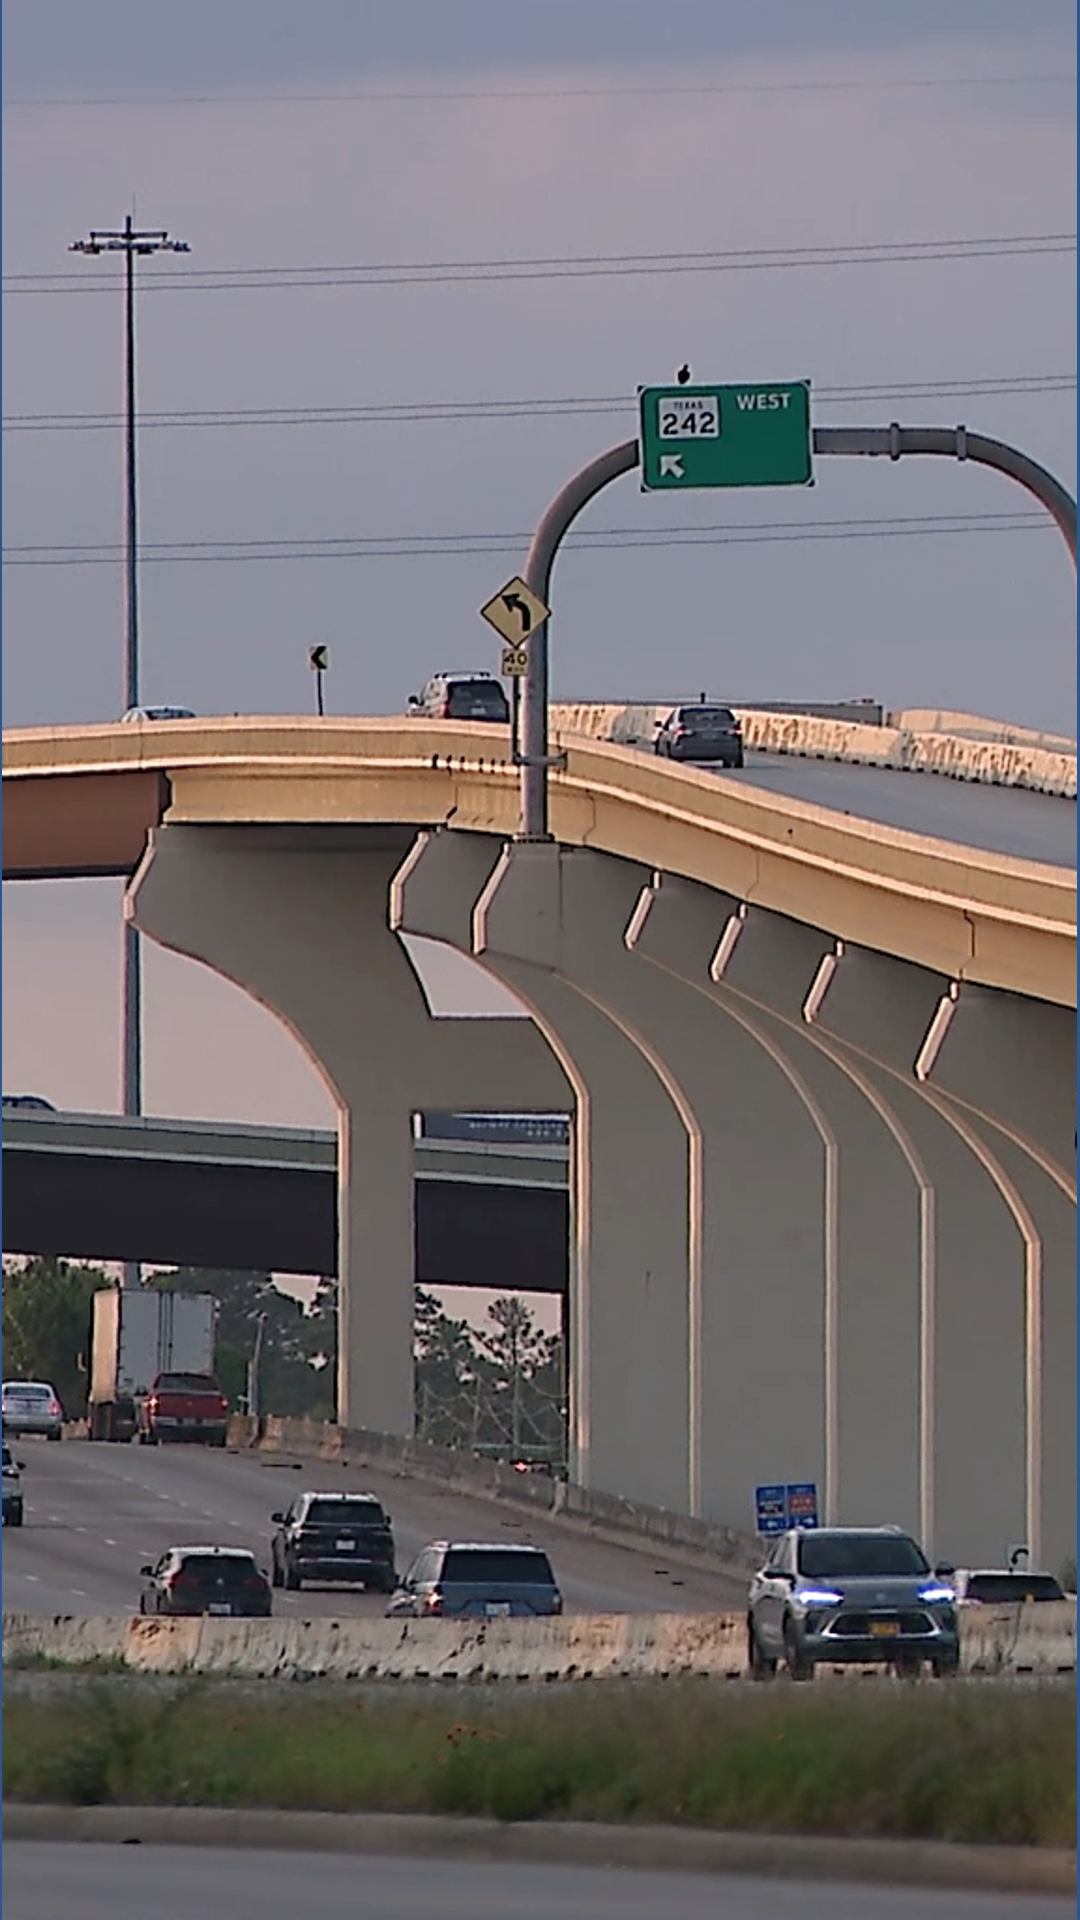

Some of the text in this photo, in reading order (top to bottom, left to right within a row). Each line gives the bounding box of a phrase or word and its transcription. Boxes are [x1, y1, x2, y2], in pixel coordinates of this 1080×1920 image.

[674, 400, 703, 410] TEXAS
[737, 393, 791, 410] WEST
[662, 411, 715, 435] 242
[503, 652, 527, 666] 40
